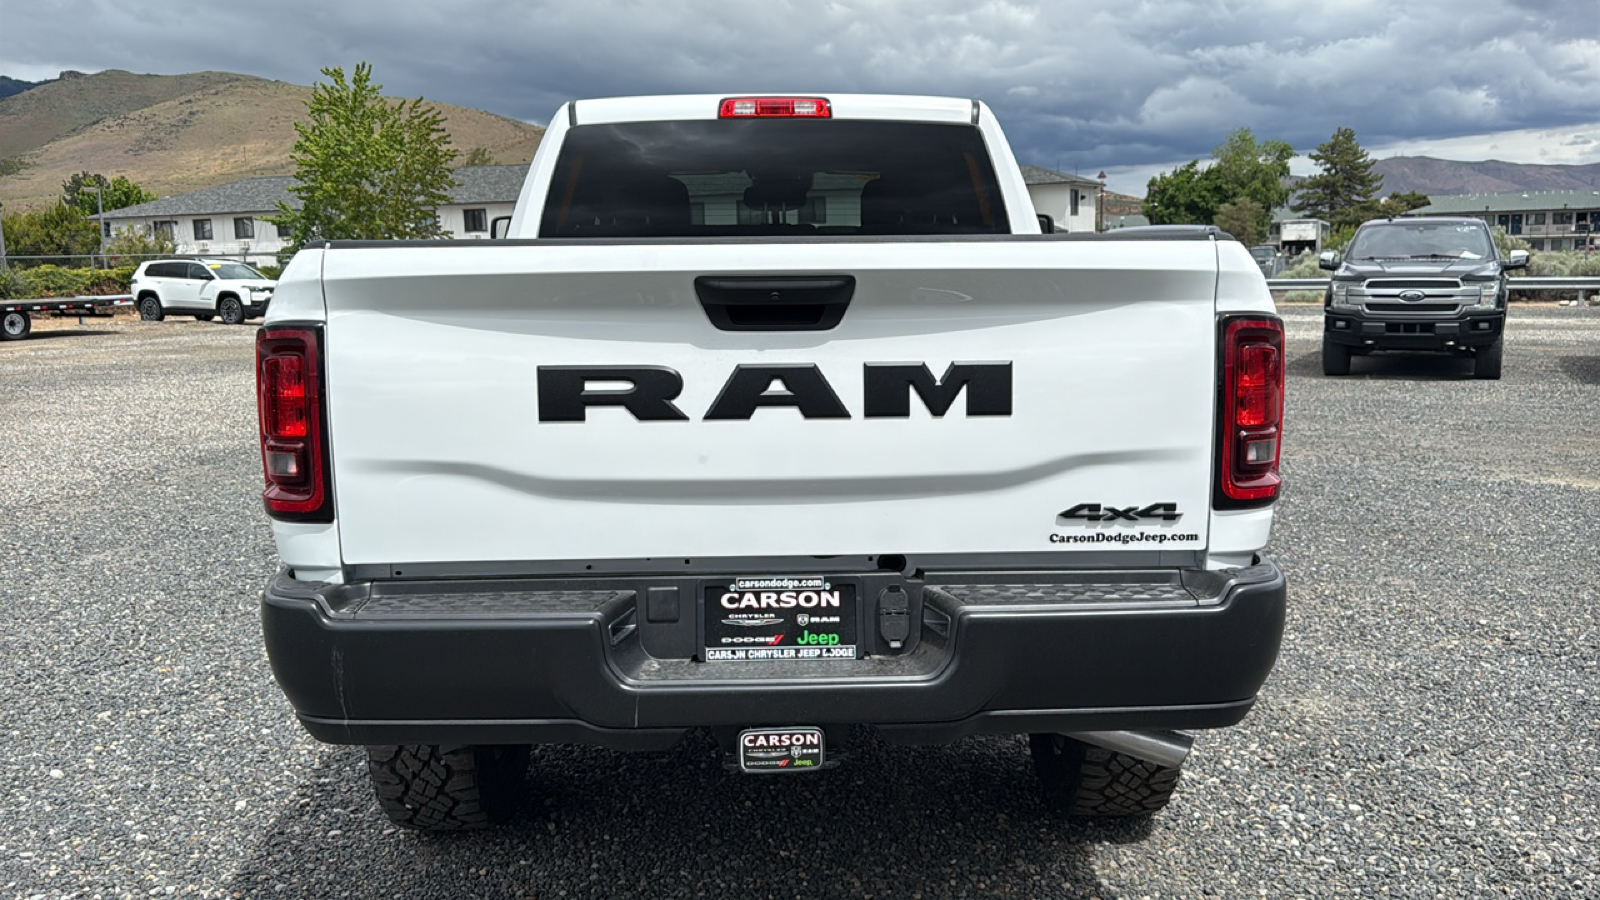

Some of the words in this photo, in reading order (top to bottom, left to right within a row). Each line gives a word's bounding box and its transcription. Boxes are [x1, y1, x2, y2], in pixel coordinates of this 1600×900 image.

[537, 360, 1013, 422] RAM
[1058, 502, 1184, 521] 4x4
[1049, 532, 1199, 544] CarsonDodgeJeep.com
[738, 578, 822, 589] carsondodge.com
[720, 591, 840, 609] CARSON
[797, 630, 840, 645] Jeep
[748, 649, 796, 659] CHRYSLER
[797, 649, 821, 658] JEEP
[744, 734, 819, 746] CARSON
